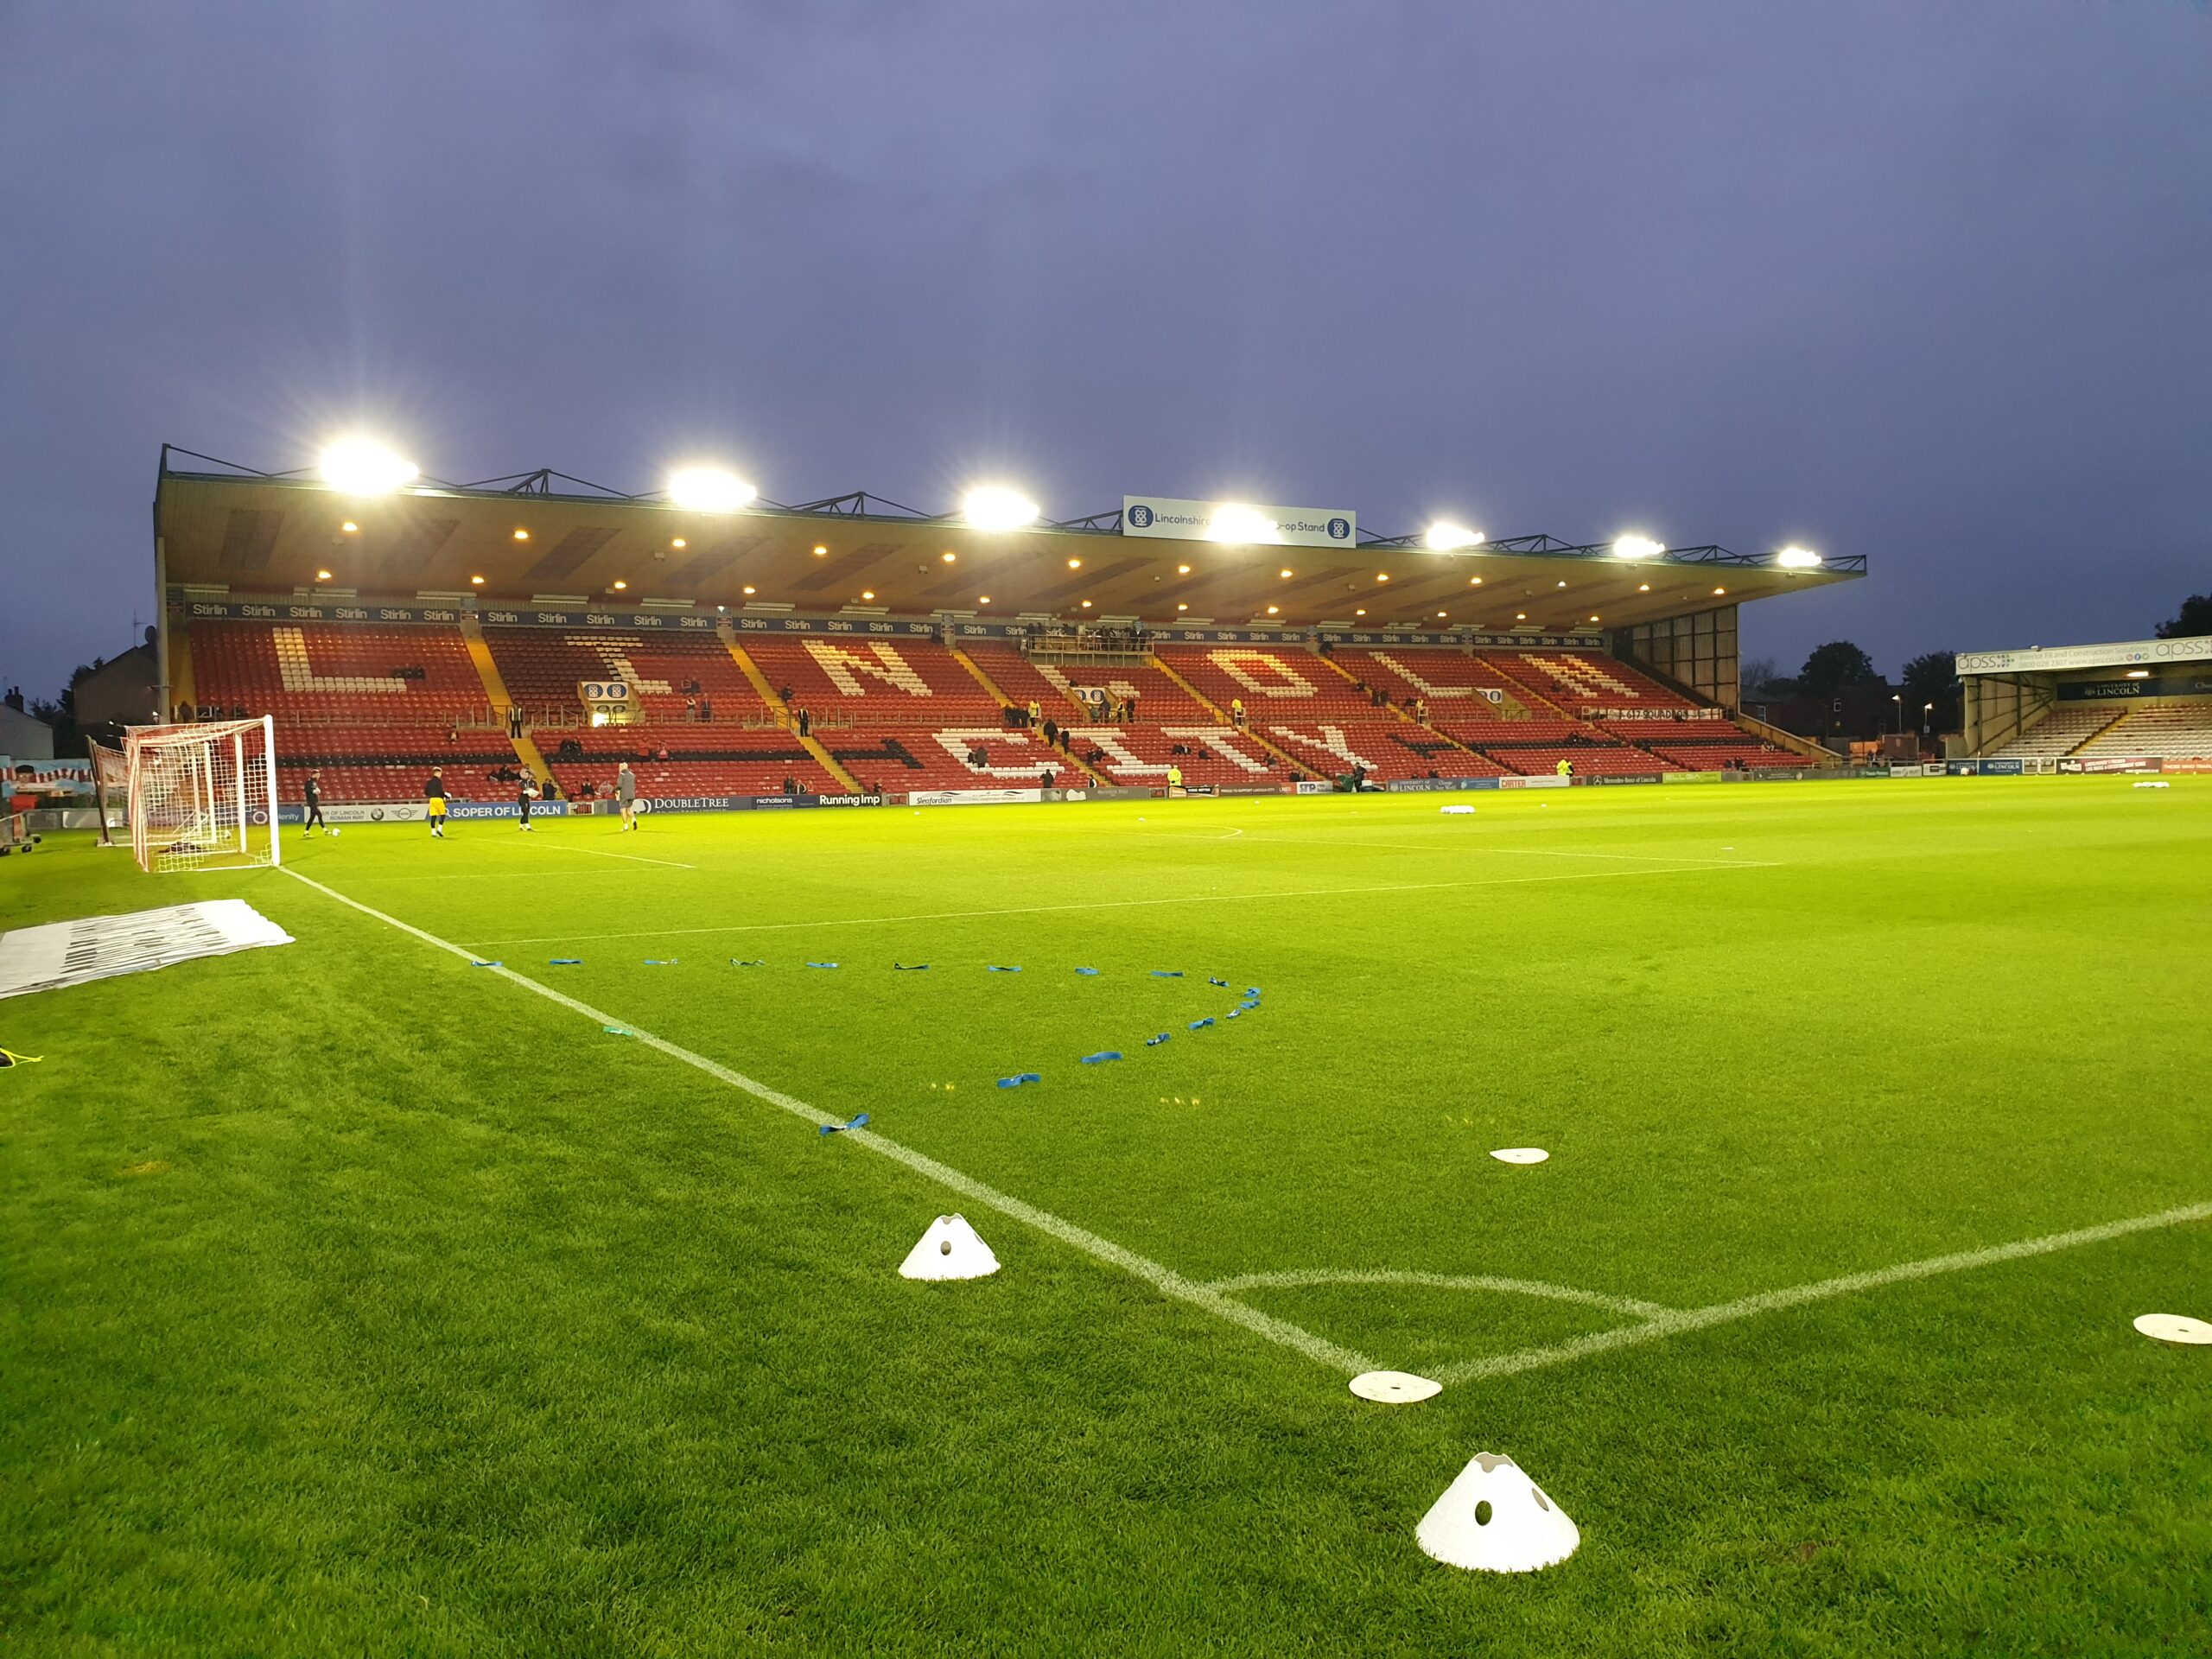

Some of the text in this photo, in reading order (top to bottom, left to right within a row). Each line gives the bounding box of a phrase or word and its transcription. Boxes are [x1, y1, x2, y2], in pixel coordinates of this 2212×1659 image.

[1155, 513, 1211, 525] Lincolnshire
[1298, 522, 1325, 533] Stand
[193, 603, 227, 614] Stirlin
[242, 605, 276, 616] Stirlin
[289, 607, 322, 618] Stirlin
[335, 607, 367, 619] Stirlin
[380, 608, 411, 620] Stirlin
[423, 609, 454, 621] Stirlin
[488, 612, 518, 622] Stirlin
[537, 613, 567, 623] Stirlin
[587, 614, 615, 625] Stirlin
[633, 615, 662, 626] Stirlin
[680, 616, 707, 626] Stirlin
[741, 618, 767, 629] Stirlin
[785, 620, 810, 630] Stirlin
[828, 620, 852, 631] Stirlin
[869, 621, 893, 632] Stirlin
[909, 623, 933, 633] Stirlin
[963, 625, 987, 634] Stirlin
[1005, 626, 1027, 635] Stirlin
[1184, 631, 1205, 639] Stirlin
[1217, 632, 1237, 640] Stirlin
[1249, 632, 1269, 641] Stirlin
[1322, 633, 1342, 642] Stirlin
[1382, 634, 1400, 643] Stirlin
[1440, 635, 1457, 644] Stirlin
[2069, 648, 2114, 657] Construction
[2156, 640, 2203, 661] apss
[1958, 655, 1997, 672] apss
[2097, 686, 2140, 696] LINCOLN
[1299, 784, 1316, 792] STP
[1399, 784, 1431, 792] LINCOLN
[1501, 779, 1526, 788] CARTER
[819, 793, 880, 806] Running Imp
[916, 797, 952, 805] Sleafordian
[453, 805, 561, 817] SOPER OF LICOLN
